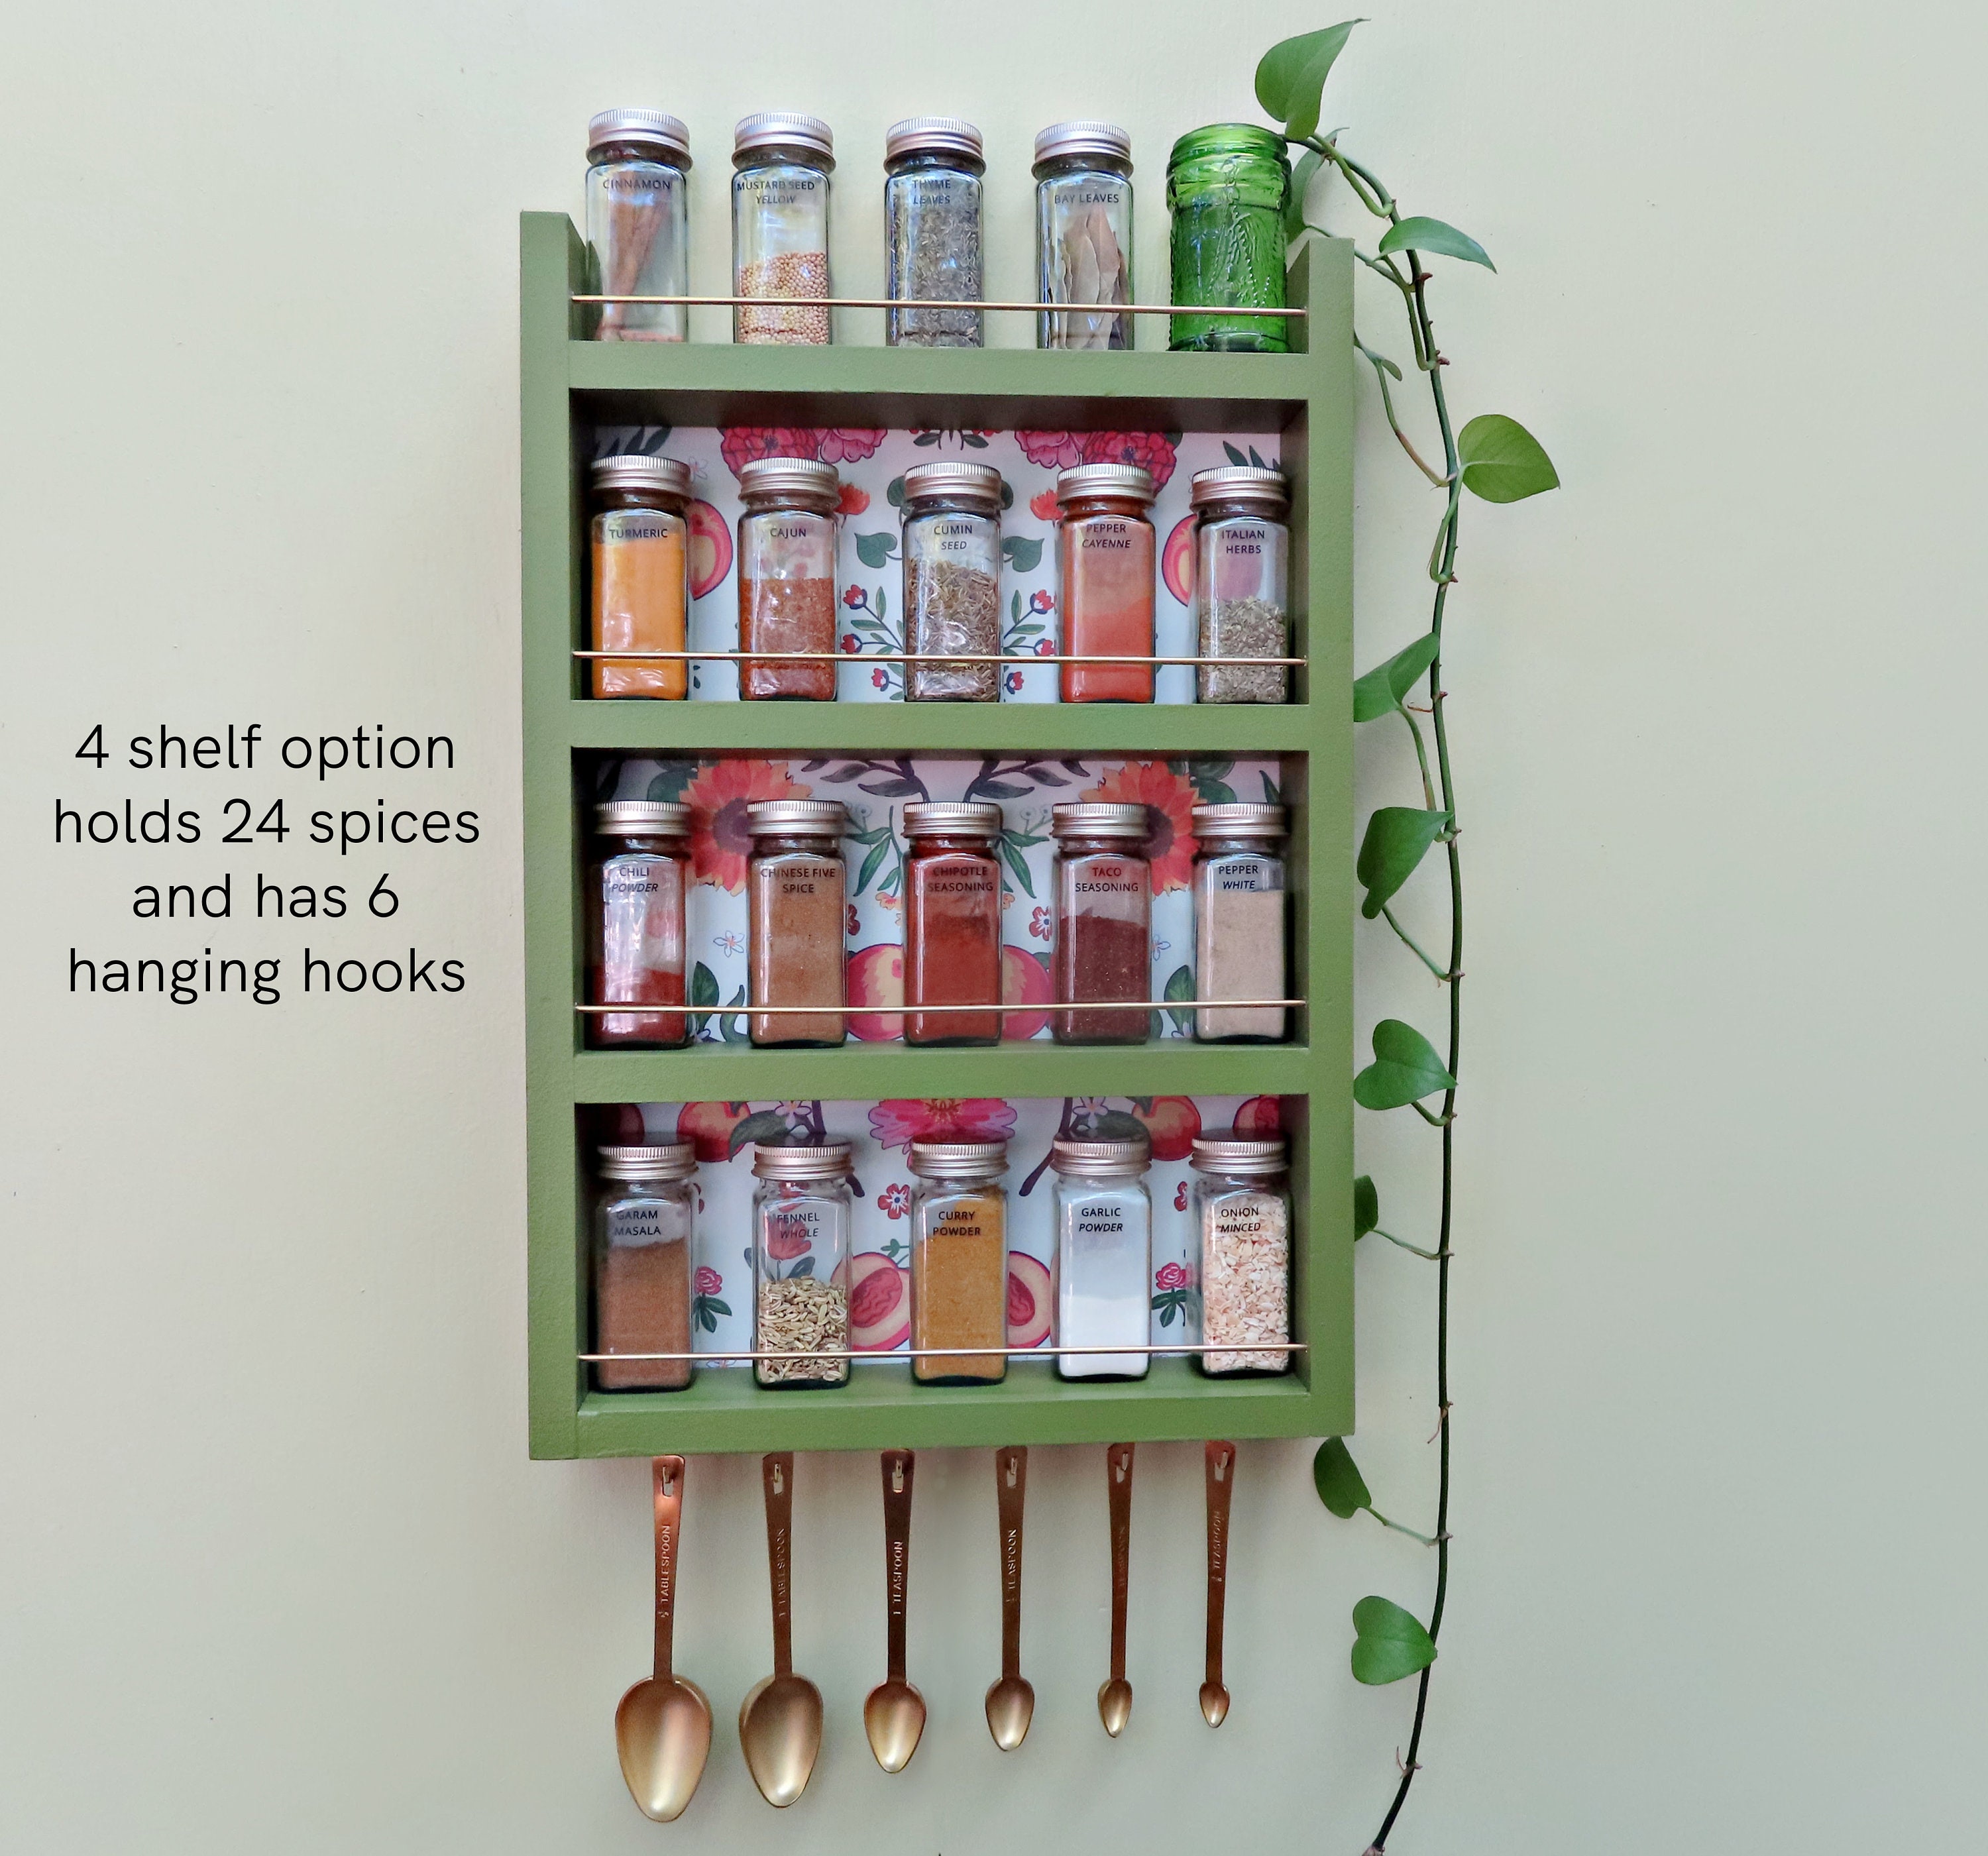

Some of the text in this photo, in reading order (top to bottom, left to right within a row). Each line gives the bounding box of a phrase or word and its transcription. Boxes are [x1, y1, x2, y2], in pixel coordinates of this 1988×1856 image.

[603, 178, 671, 190] CINNAMON
[736, 180, 815, 191] MUSTARD SEED
[912, 179, 952, 190] THYME
[755, 195, 796, 204] YELLOW
[912, 195, 951, 205] LEAVES
[1054, 193, 1120, 205] BAY LEAVES
[608, 528, 669, 539] TURMERIC
[769, 527, 808, 539] CAJUN
[933, 525, 973, 535] CUMIN
[1086, 523, 1127, 533] PEPPER
[1221, 529, 1265, 539] ITALIAN
[940, 540, 967, 551] SEED
[1081, 539, 1132, 549] CAYENNE
[1226, 545, 1262, 555] HERBS
[619, 866, 650, 877] CHILI
[761, 867, 836, 878] CHINESE FIVE
[932, 866, 988, 877] CHIPOTLE
[1091, 867, 1123, 877] TACO
[1218, 865, 1259, 875] PEPPER
[611, 883, 659, 893] POWDER
[782, 883, 815, 894] SPICE
[928, 882, 994, 892] SEASONING
[1074, 882, 1140, 893] SEASONING
[1223, 880, 1256, 890] WHITE
[616, 1209, 659, 1220] GARAM
[777, 1211, 820, 1223] FENNEL
[938, 1211, 976, 1222] CURRY
[1081, 1207, 1121, 1218] GARLIC
[1221, 1207, 1260, 1218] ONION
[614, 1225, 662, 1236] MASALA
[780, 1227, 820, 1239] WHOLE
[932, 1226, 981, 1236] POWDER
[1078, 1222, 1124, 1233] POWDER
[1220, 1222, 1261, 1233] MINCED
[660, 1524, 671, 1604] TABLESPOON
[893, 1541, 903, 1603] TEASPOON
